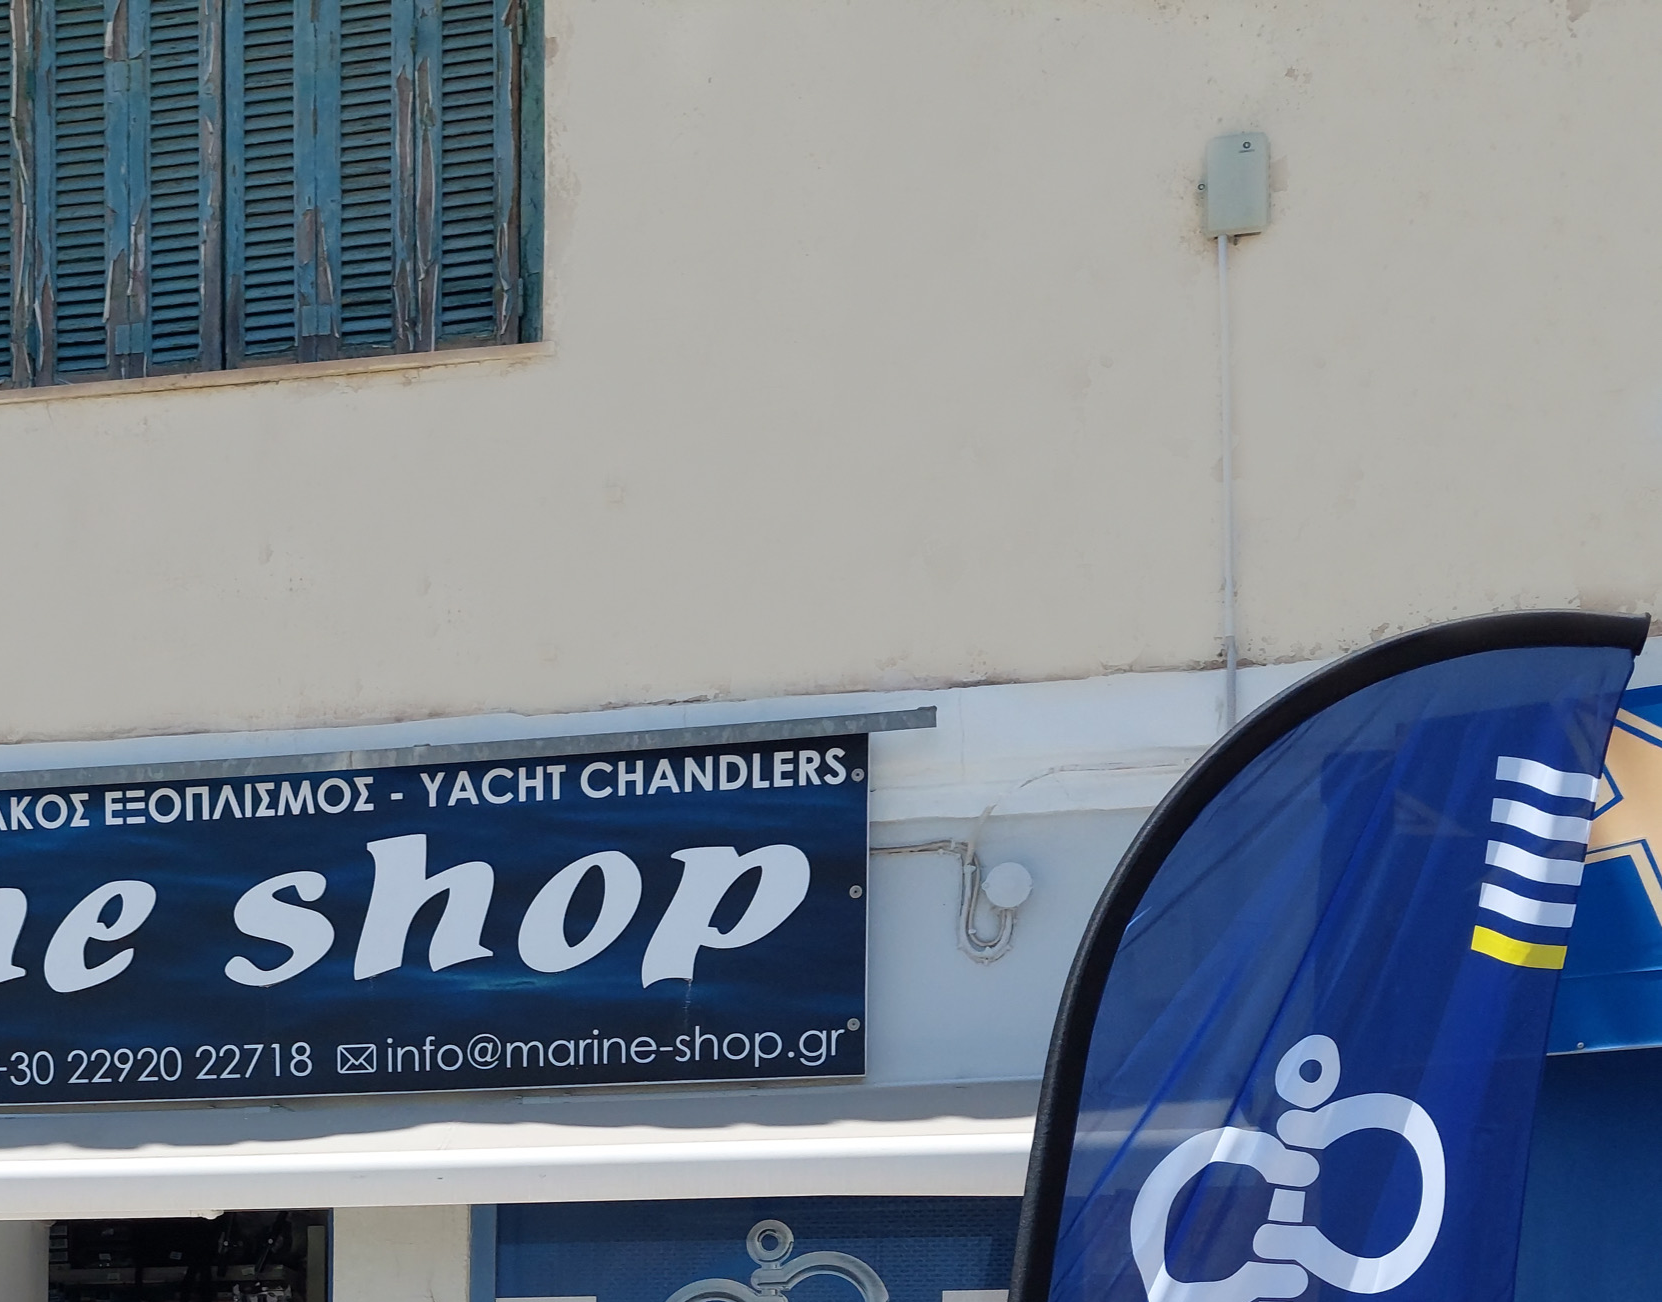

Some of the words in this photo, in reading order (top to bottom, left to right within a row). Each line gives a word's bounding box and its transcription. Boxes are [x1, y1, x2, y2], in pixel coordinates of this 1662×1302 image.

[104, 777, 375, 826] ΕΞΟΠΛΙΣΜΟΣ
[419, 762, 567, 808] YACHT
[578, 749, 847, 799] CHANDLERS
[224, 833, 811, 989] shop
[67, 1046, 182, 1084] 22920
[195, 1041, 313, 1080] 22718
[386, 1025, 845, 1076] info@marine-shop.gr
